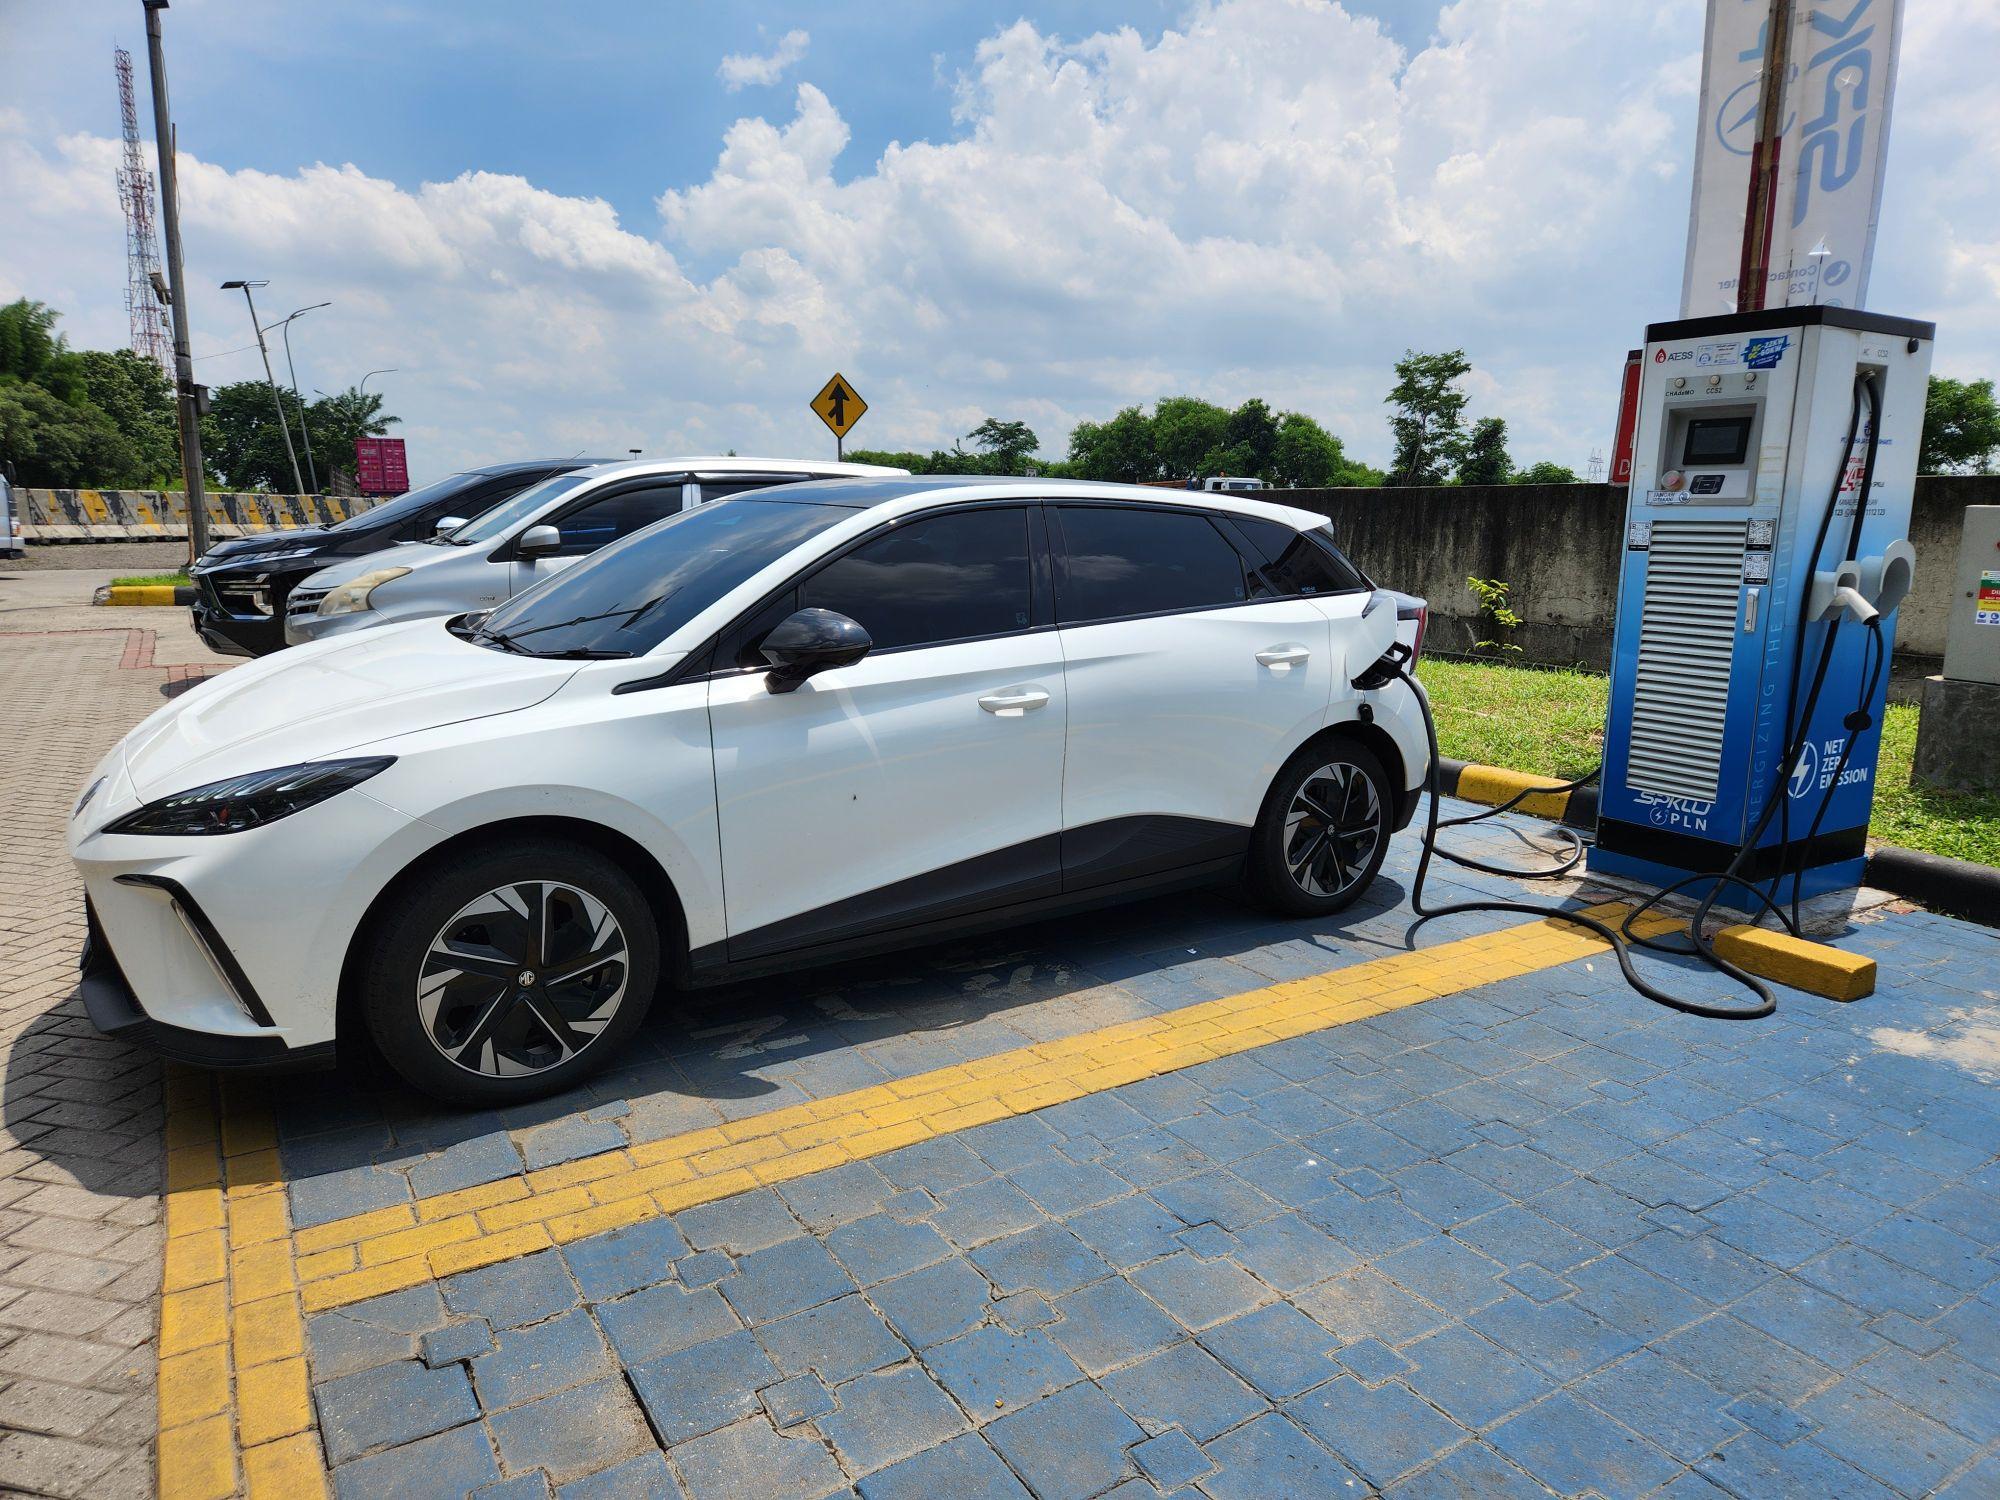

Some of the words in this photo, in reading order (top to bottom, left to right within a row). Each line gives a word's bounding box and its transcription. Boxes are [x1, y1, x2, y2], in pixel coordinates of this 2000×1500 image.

[1667, 351, 1693, 361] ATESS
[1765, 623, 1784, 670] THE
[1823, 739, 1846, 756] NET
[1820, 756, 1849, 773] ZER
[1819, 767, 1868, 789] EMSSION
[1632, 791, 1711, 816] SPKLU
[1670, 812, 1707, 832] PLN
[518, 970, 536, 987] MG
